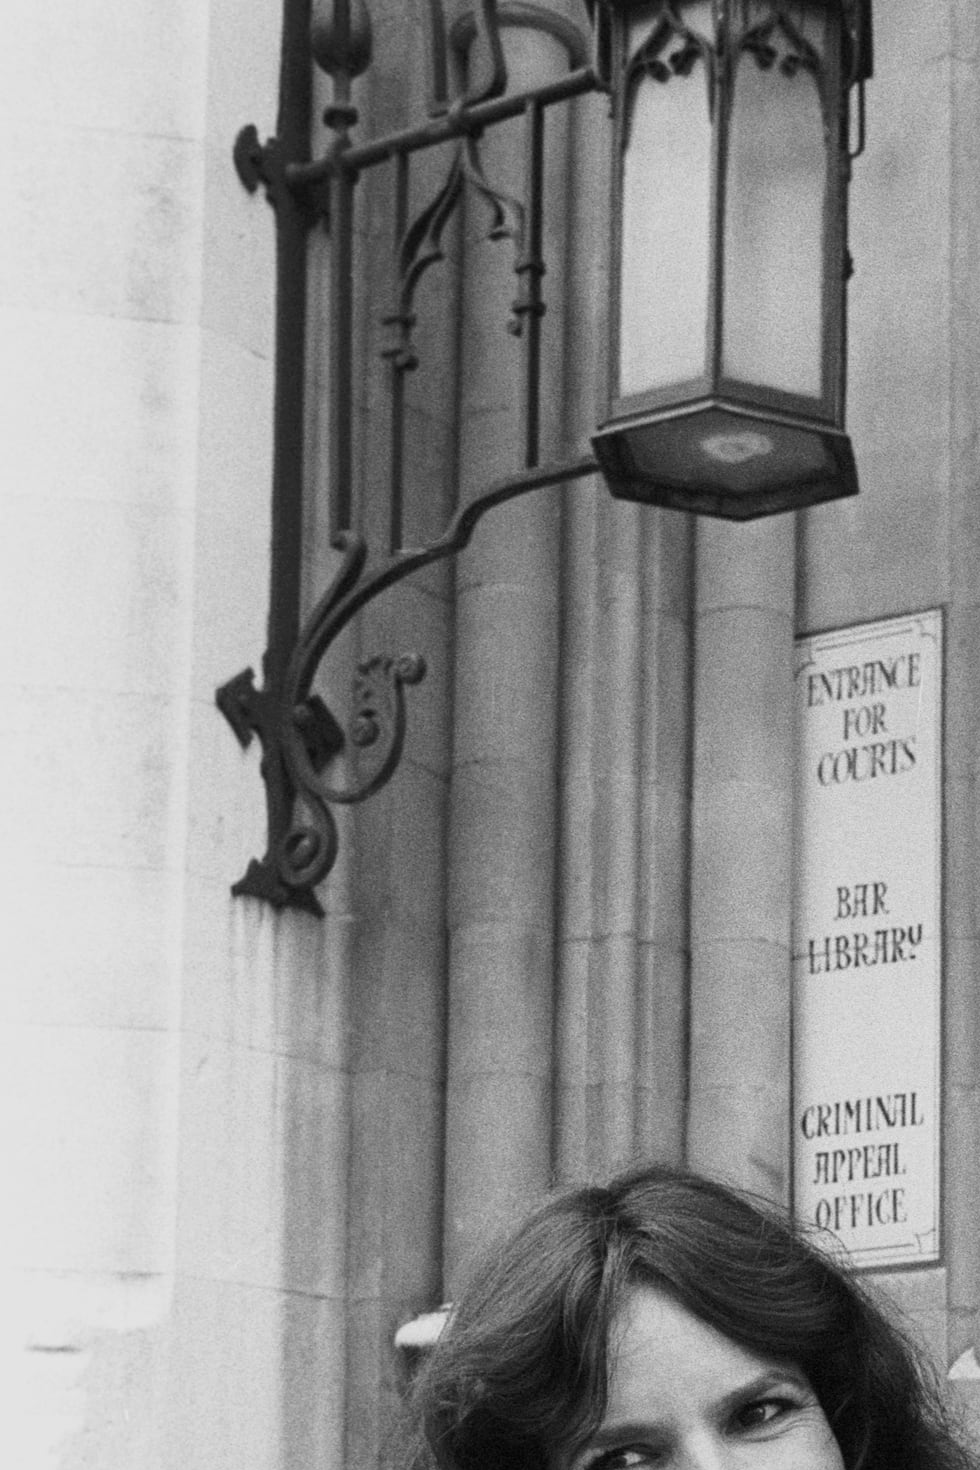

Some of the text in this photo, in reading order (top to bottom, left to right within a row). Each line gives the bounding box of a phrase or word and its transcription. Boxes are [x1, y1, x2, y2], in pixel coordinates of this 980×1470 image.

[808, 652, 920, 707] ENTRANCE
[843, 702, 888, 740] FOR
[817, 735, 916, 787] COURTS
[834, 881, 890, 920] BAR
[809, 923, 922, 975] LIBRARY
[801, 1092, 924, 1140] CRIMINAL
[813, 1142, 907, 1185] APPEAL
[815, 1188, 908, 1232] OFFICE
